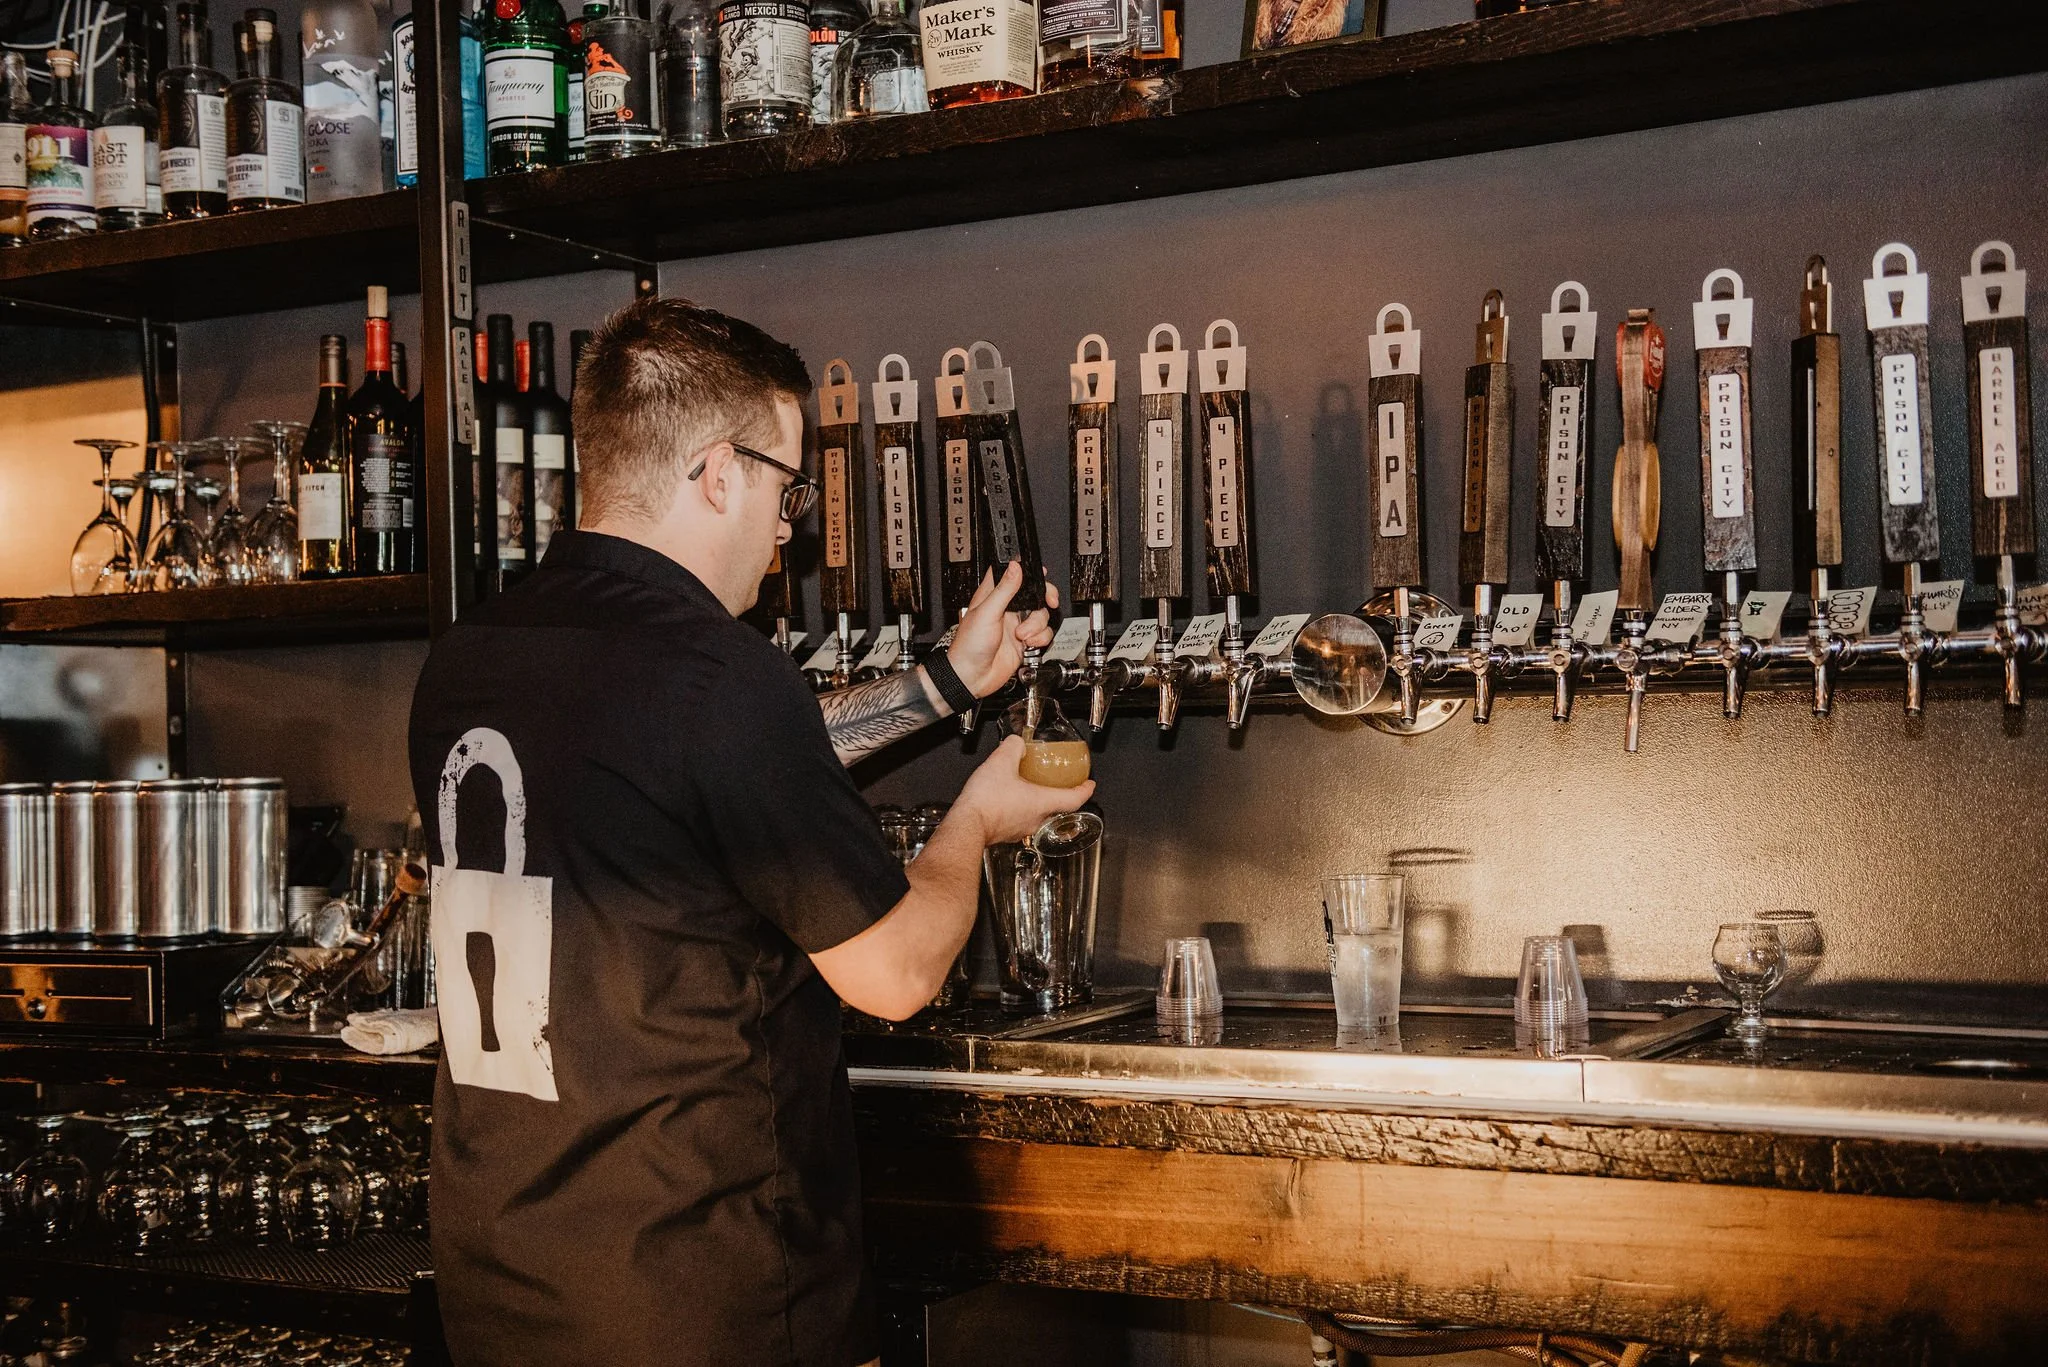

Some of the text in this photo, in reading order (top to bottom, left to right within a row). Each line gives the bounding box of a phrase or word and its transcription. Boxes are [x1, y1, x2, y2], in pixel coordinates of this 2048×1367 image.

[745, 7, 777, 15] MEXICO
[925, 6, 995, 30] Maker's
[944, 23, 996, 43] Mark
[937, 45, 984, 58] WHISKY
[487, 80, 545, 96] Tanqueray
[588, 89, 617, 110] Gin
[308, 121, 350, 137] GOOSE
[491, 133, 512, 143] LONDON
[97, 142, 127, 155] AST
[235, 164, 262, 173] BOURBON
[456, 209, 467, 312] RIOT
[458, 331, 473, 440] PALE ALE
[1892, 363, 1910, 494] PRISON CITY
[1991, 353, 2005, 491] BARREL AGED
[1471, 404, 1479, 469] PRISON
[1718, 382, 1733, 508] PRISON CITY
[1556, 395, 1571, 518] PRISON CITY
[986, 446, 1003, 494] MASS
[1217, 423, 1229, 540] 4 PIECE
[1385, 411, 1402, 528] IPA
[1084, 436, 1095, 547] PRISON CITY
[1155, 426, 1165, 540] 4 PIECE
[831, 489, 839, 503] IN
[891, 453, 904, 563] PILSNER
[952, 446, 963, 554] PRISON CITY
[832, 512, 841, 563] VERMONT
[1502, 606, 1530, 616] OLD
[1663, 605, 1704, 614] CIDER
[1664, 594, 1710, 604] EMBARK
[874, 639, 899, 655] VT
[1183, 630, 1219, 642] GALAXY
